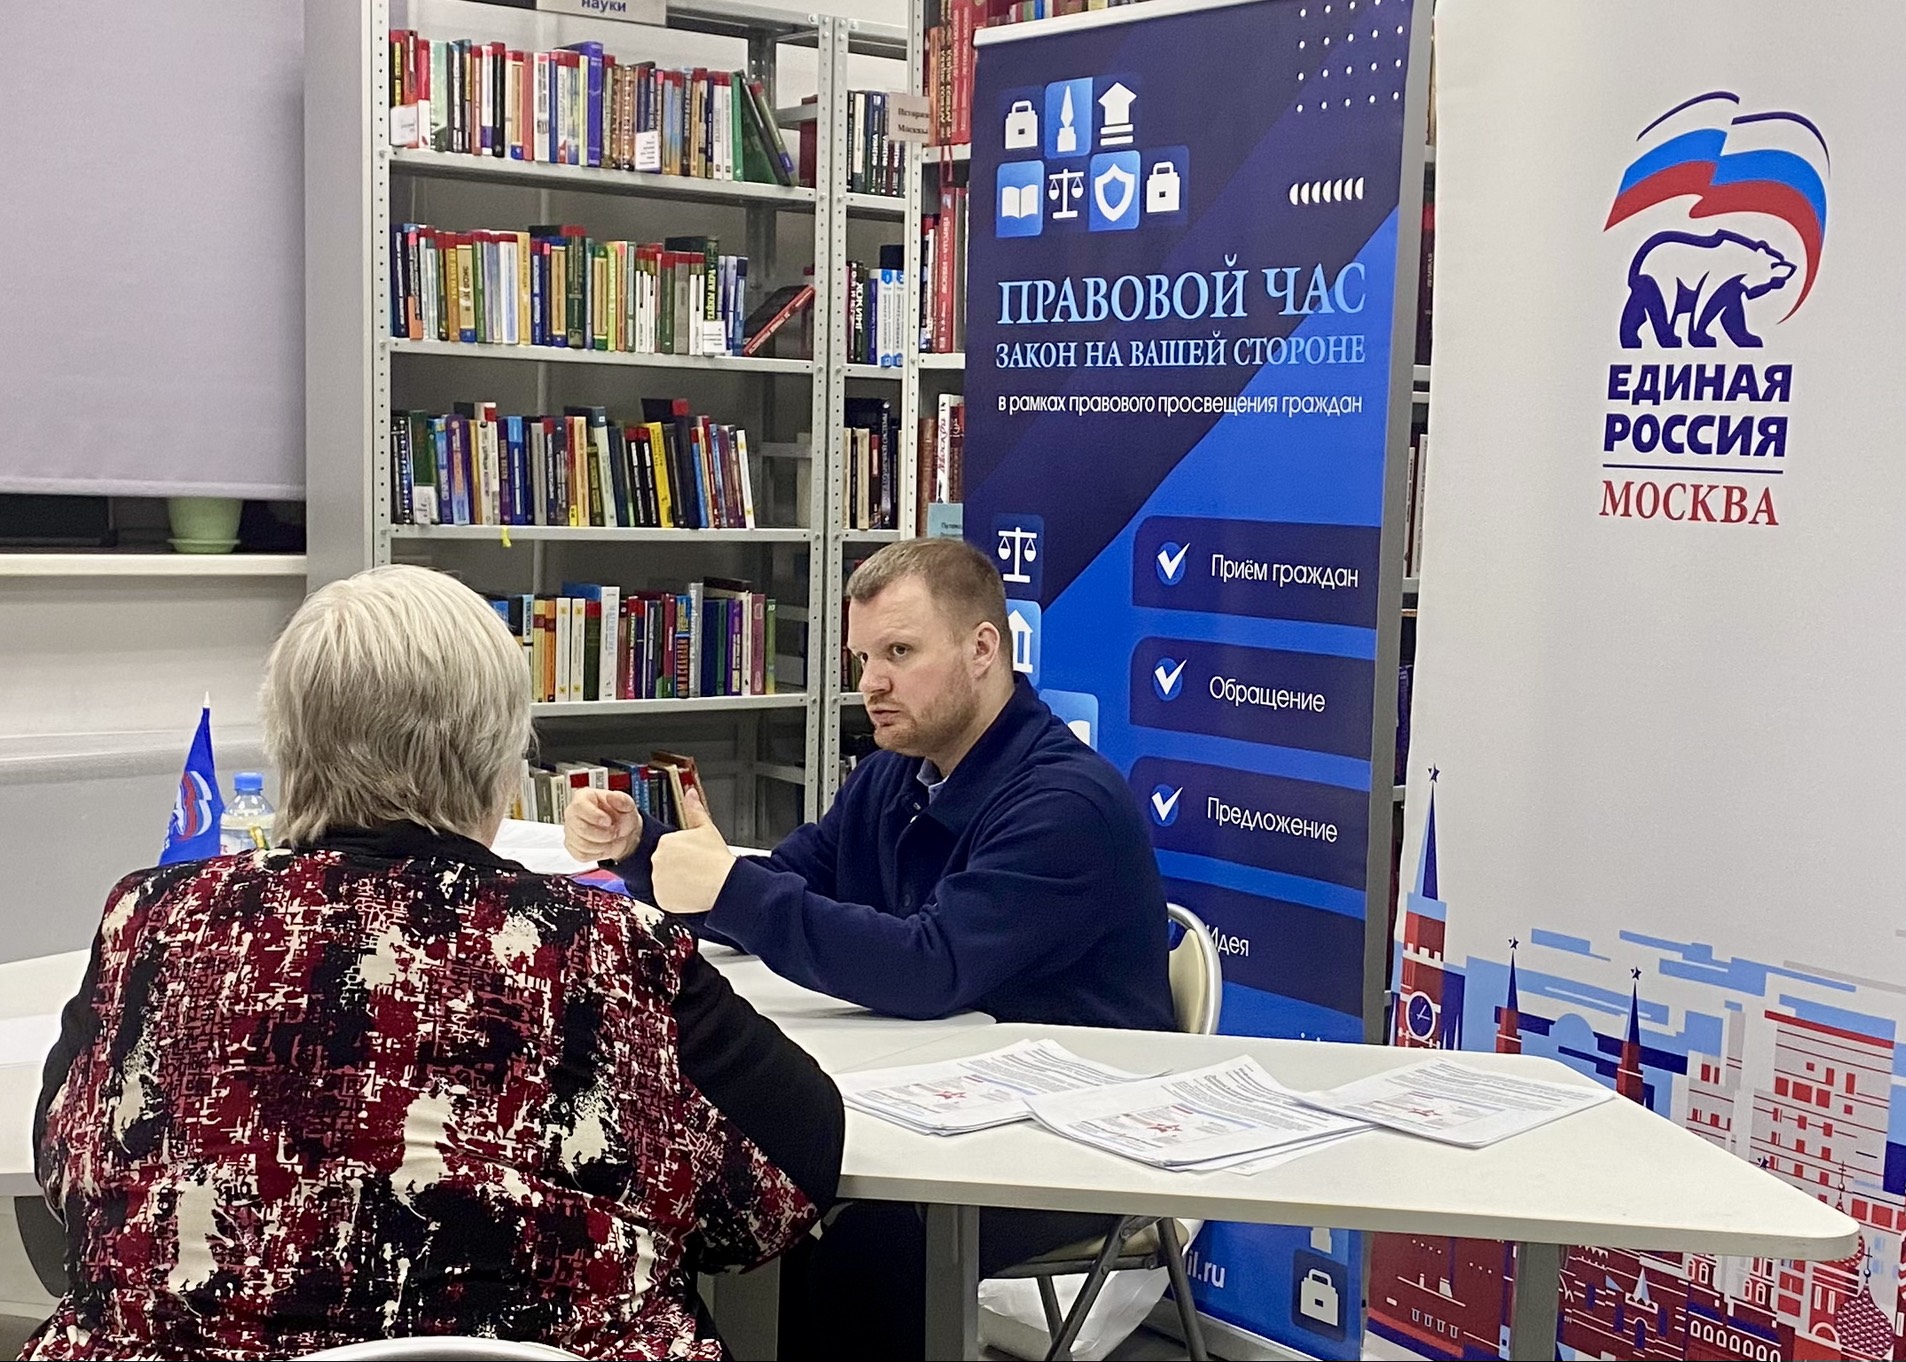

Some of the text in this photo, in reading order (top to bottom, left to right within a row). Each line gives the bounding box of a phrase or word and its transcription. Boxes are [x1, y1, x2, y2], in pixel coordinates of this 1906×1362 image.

[856, 282, 864, 332] ХОКИНГ
[997, 254, 1250, 325] ПРАВОВОЙ
[1262, 262, 1366, 317] ЧАС
[996, 331, 1366, 368] ЗАКОН НА ВАШЕЙ СТОРОНЕ
[1608, 364, 1793, 406] ЕДИНАЯ
[998, 395, 1362, 418] в рамках правового просвещения граждан
[1603, 413, 1788, 458] РОССИЯ
[1599, 480, 1779, 526] МОСКВА
[1211, 553, 1359, 589] Приём граждан
[1209, 676, 1326, 714] Обращение
[1207, 796, 1338, 843] Предложение
[1206, 924, 1250, 958] Идея
[1186, 1249, 1226, 1289] il.ru
